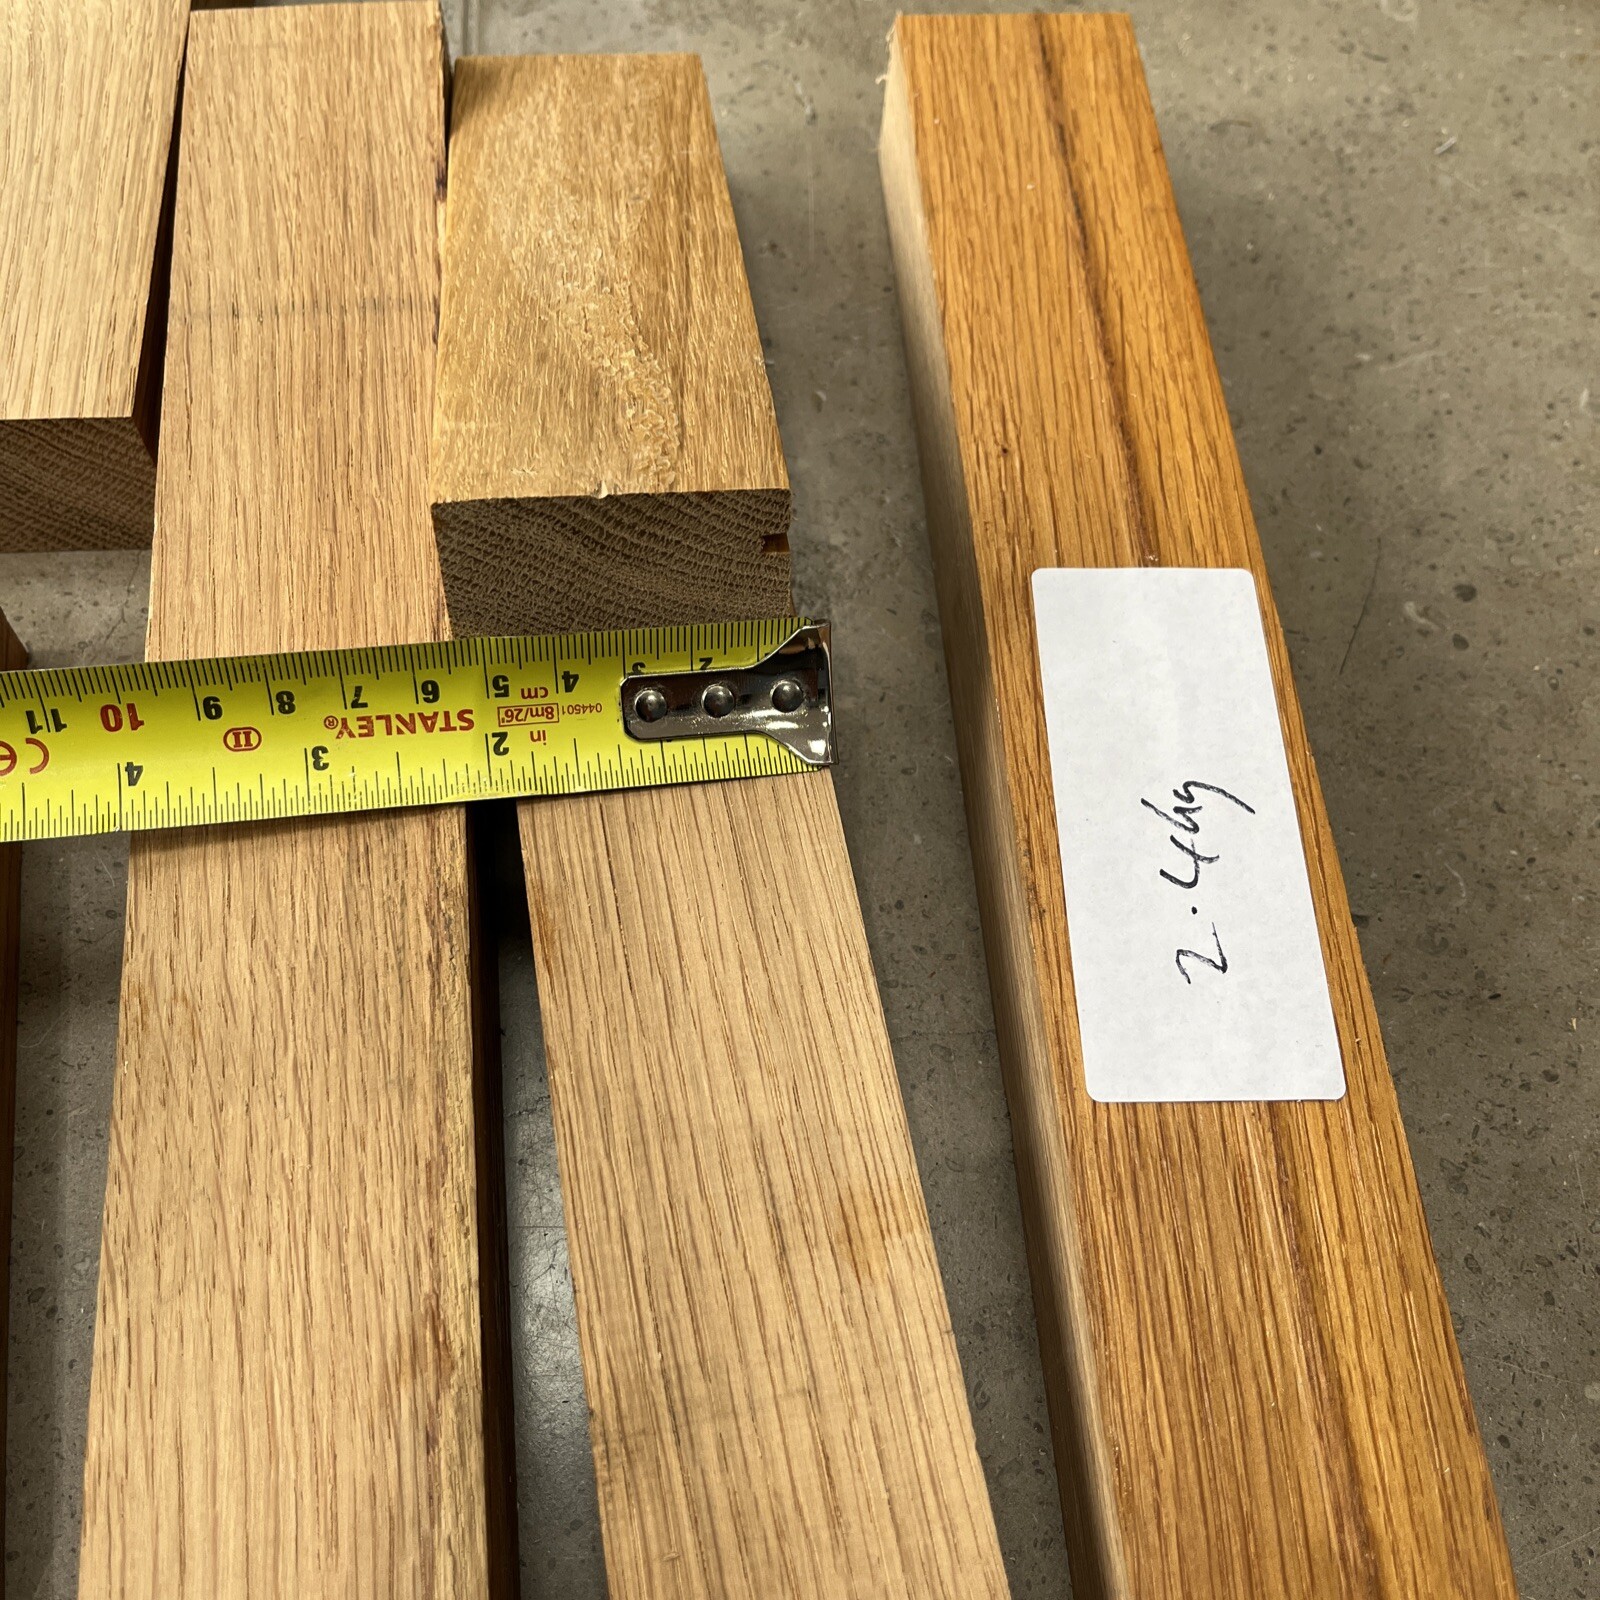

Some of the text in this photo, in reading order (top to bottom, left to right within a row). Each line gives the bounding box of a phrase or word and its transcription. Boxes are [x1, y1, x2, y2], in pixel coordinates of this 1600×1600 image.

[421, 680, 440, 703] 6
[492, 675, 510, 698] 5
[521, 687, 549, 699] cm
[562, 671, 579, 693] 4
[203, 696, 223, 720] 9
[275, 691, 296, 714] 8
[351, 686, 368, 708] 7
[25, 708, 67, 734] 11
[100, 703, 145, 732] 10
[561, 703, 603, 716] 044501
[530, 730, 547, 745] in
[125, 732, 510, 787] 2 3 4
